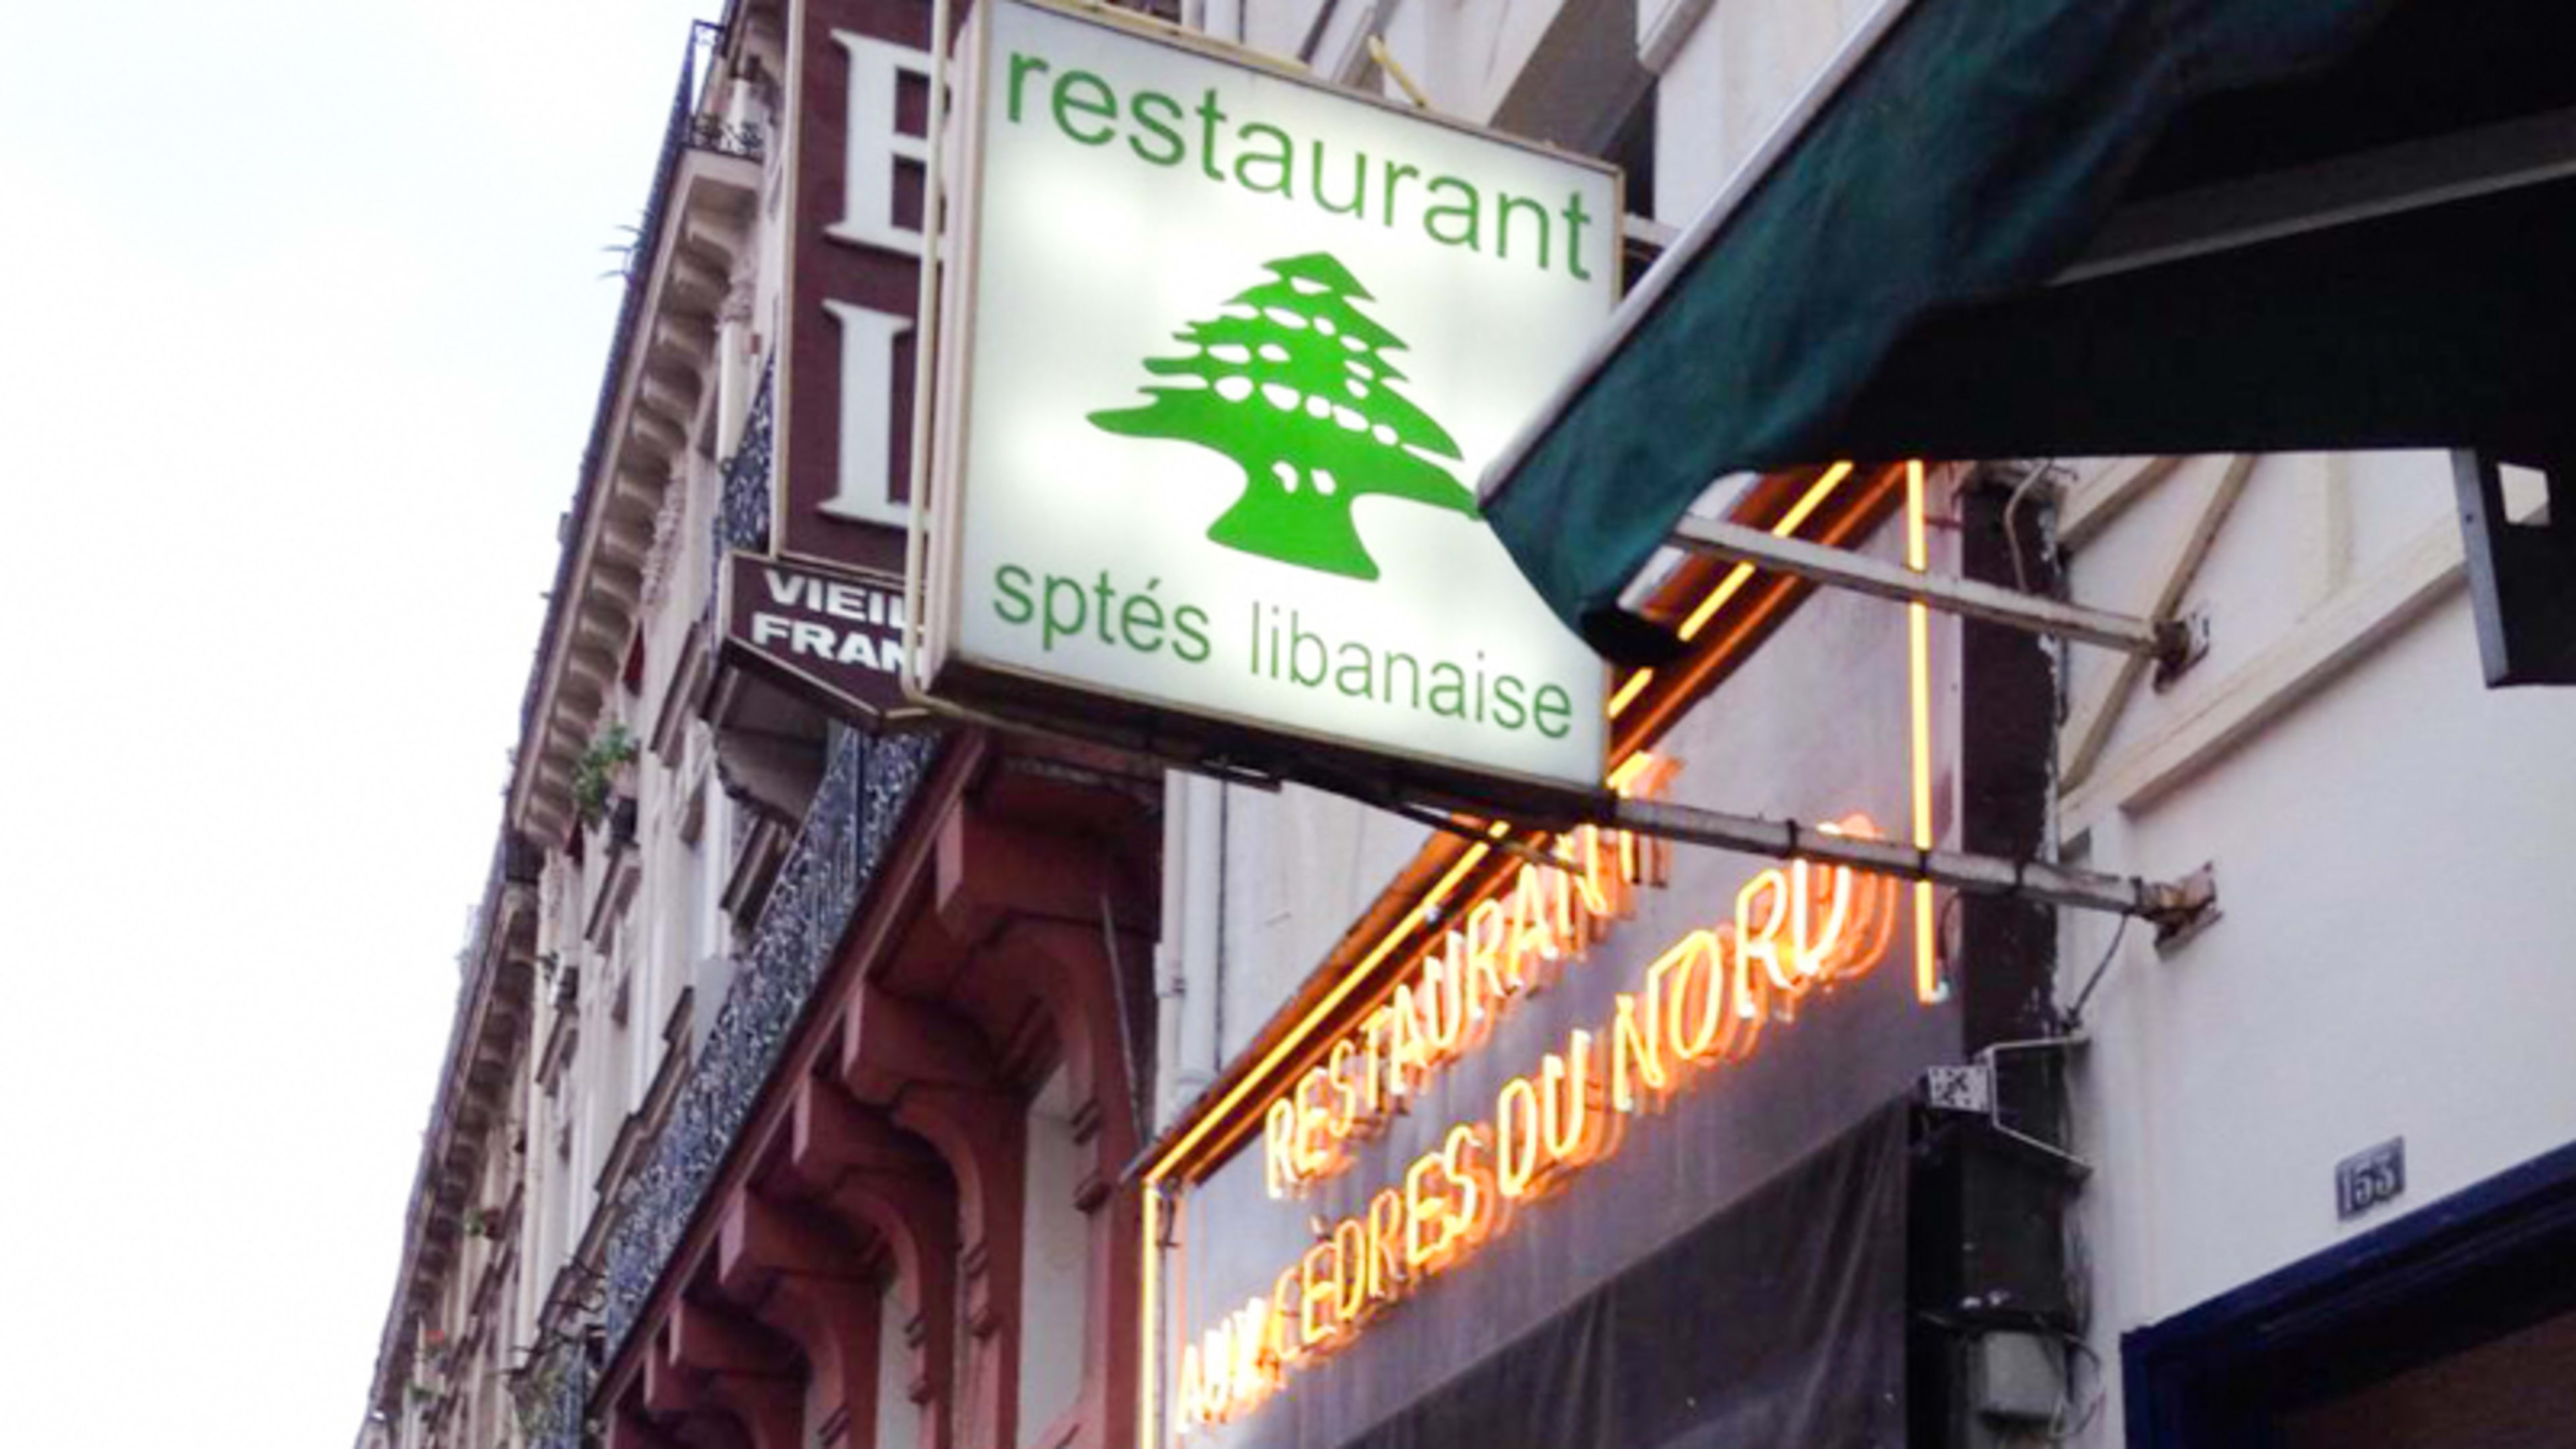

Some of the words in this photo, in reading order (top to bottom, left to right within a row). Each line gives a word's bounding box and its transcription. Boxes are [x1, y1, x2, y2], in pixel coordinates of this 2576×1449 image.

[1006, 50, 1593, 282] restaurant
[992, 564, 1212, 664] sptés
[1249, 600, 1573, 739] libanaise
[1264, 750, 1654, 1199] RESTAURANT
[1496, 1028, 1593, 1197] DU
[1613, 821, 1853, 1112] NORD
